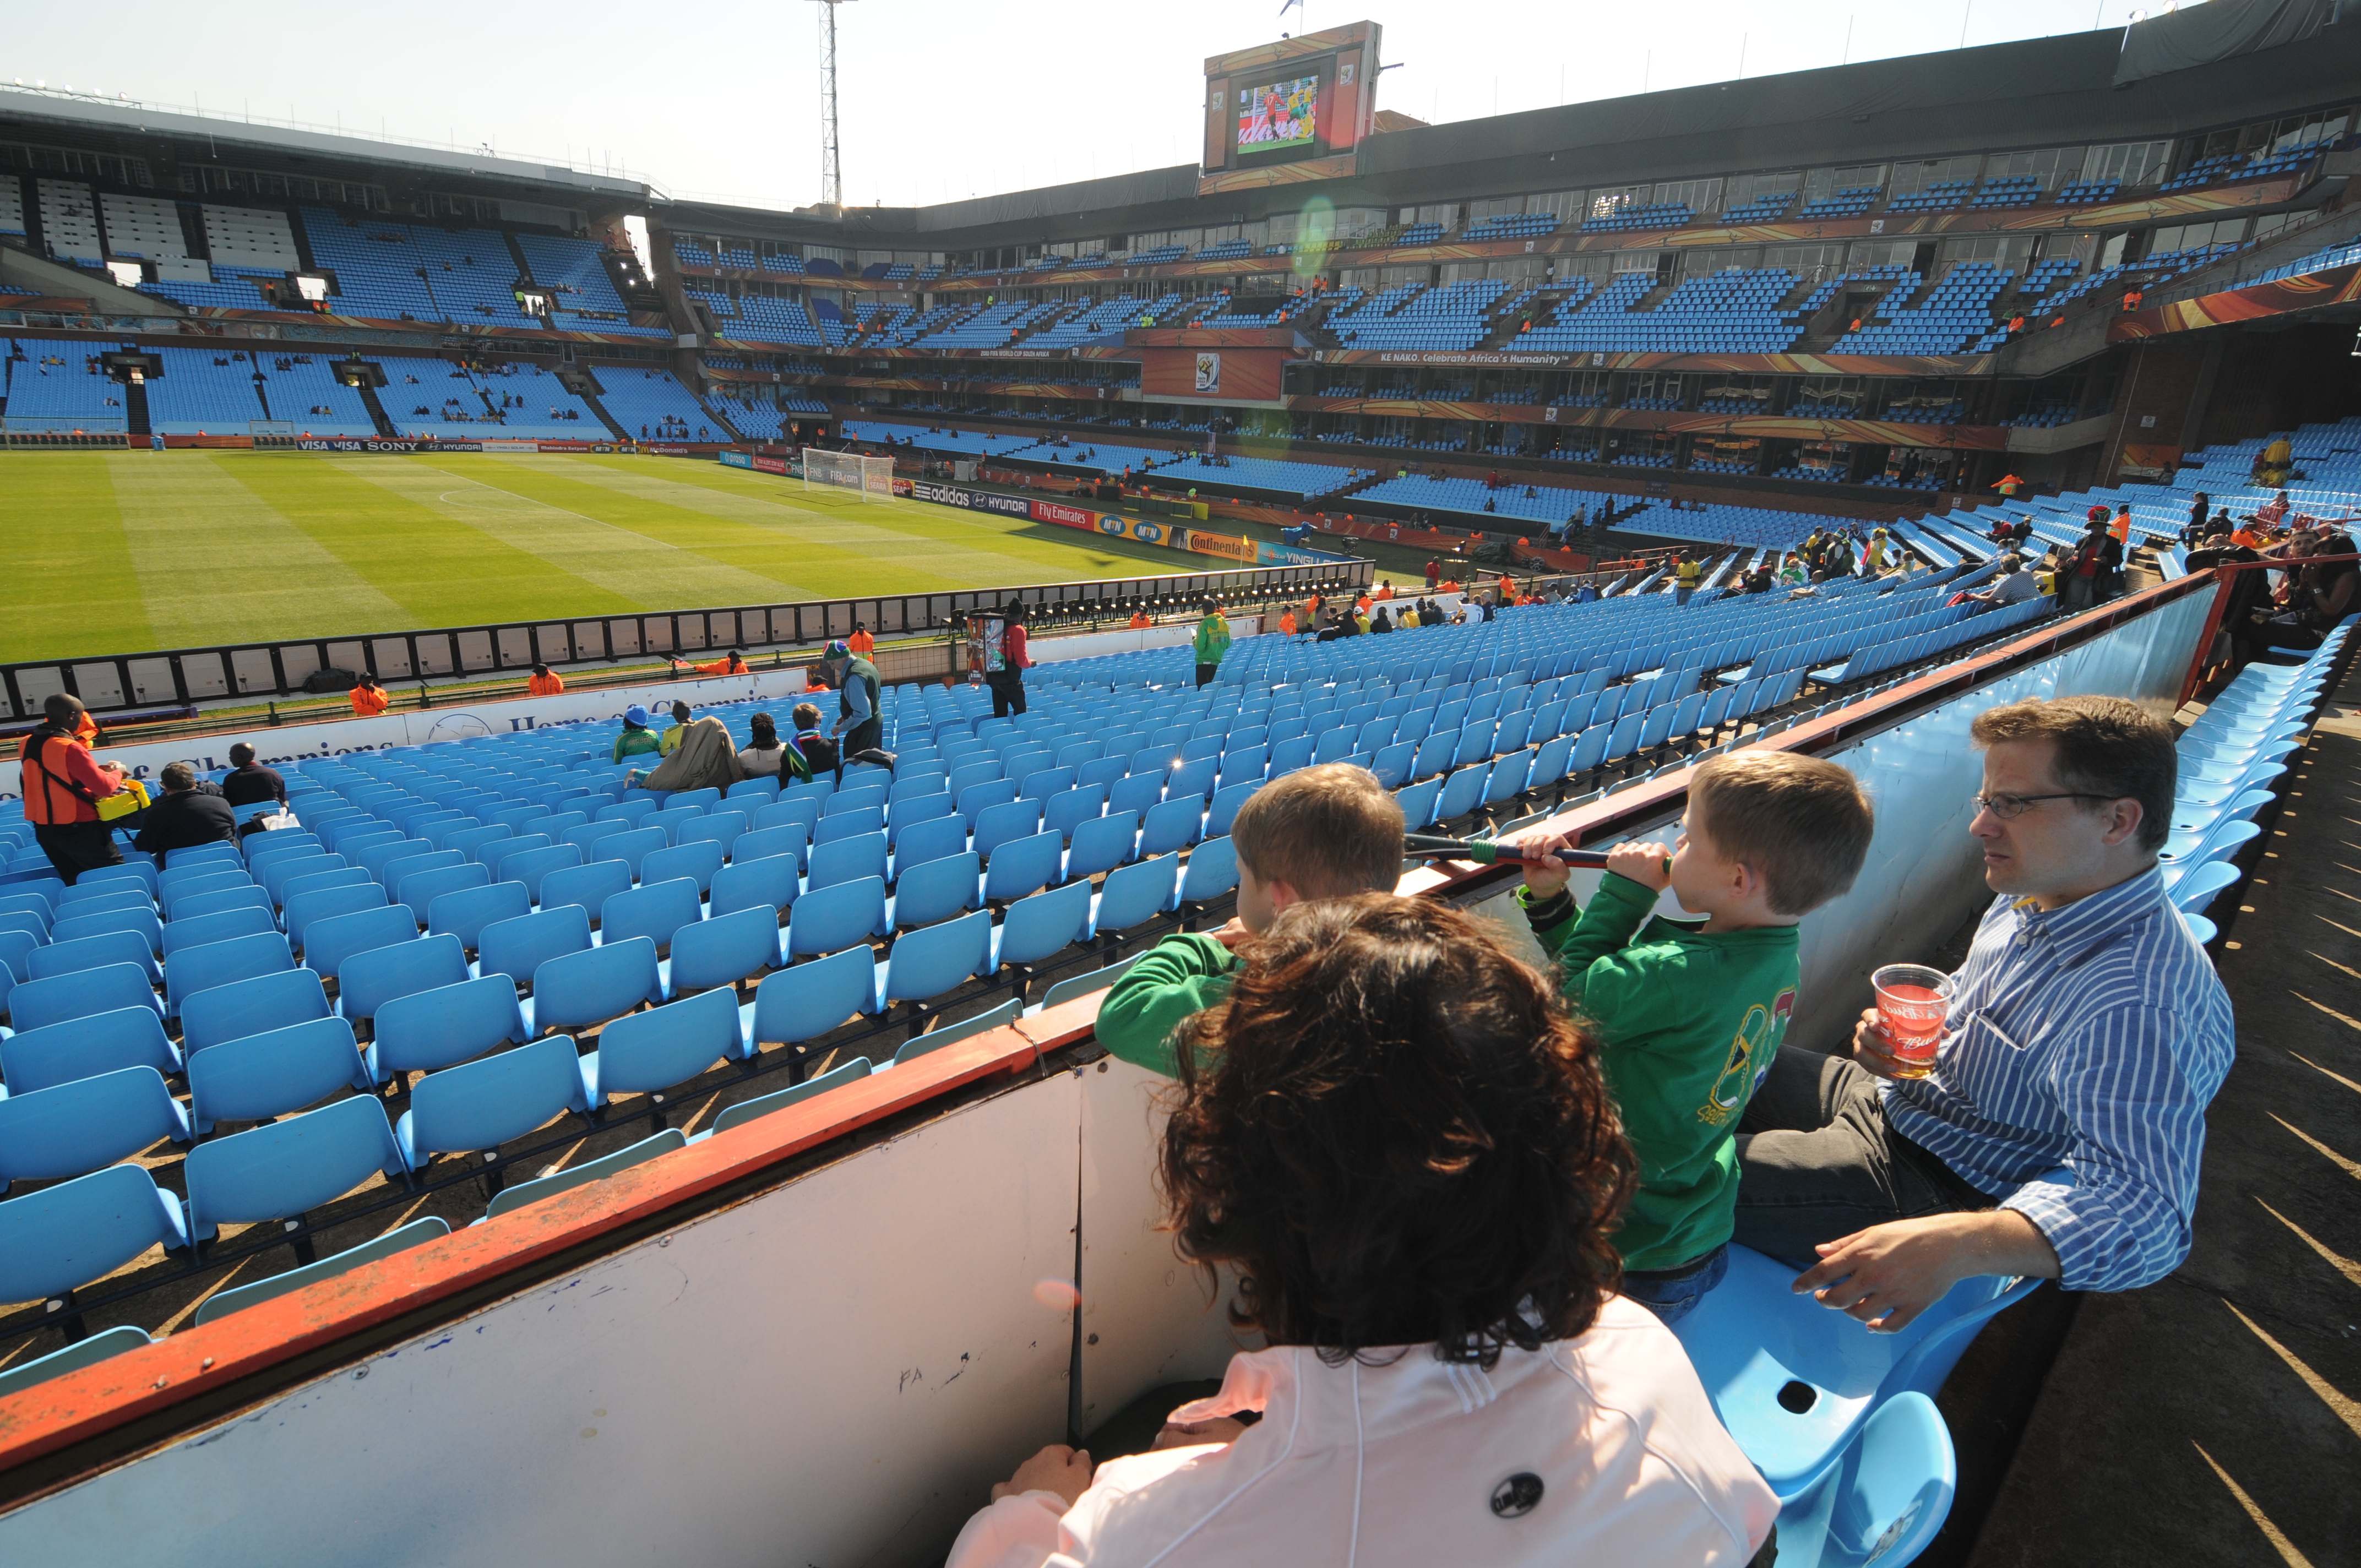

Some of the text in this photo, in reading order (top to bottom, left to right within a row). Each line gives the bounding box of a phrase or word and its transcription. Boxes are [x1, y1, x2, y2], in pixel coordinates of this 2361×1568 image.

[1381, 353, 1391, 362] KE
[1393, 353, 1420, 362] NAKO.
[1423, 353, 1467, 363] Celebrate
[1469, 353, 1508, 363] Africa's
[300, 441, 329, 450] VISA
[333, 441, 361, 450] VISA
[367, 442, 418, 451] SONY
[730, 454, 746, 465] prasa
[791, 464, 803, 475] FNB
[809, 467, 822, 477] FNB
[830, 470, 858, 484] FIFAcom
[869, 482, 886, 491] SEARA
[931, 486, 969, 507] adidas
[988, 497, 1027, 513] HYUNDAI
[1039, 503, 1086, 524] Fly Emirates
[1103, 519, 1122, 532] MTN
[1138, 525, 1157, 538] MTN
